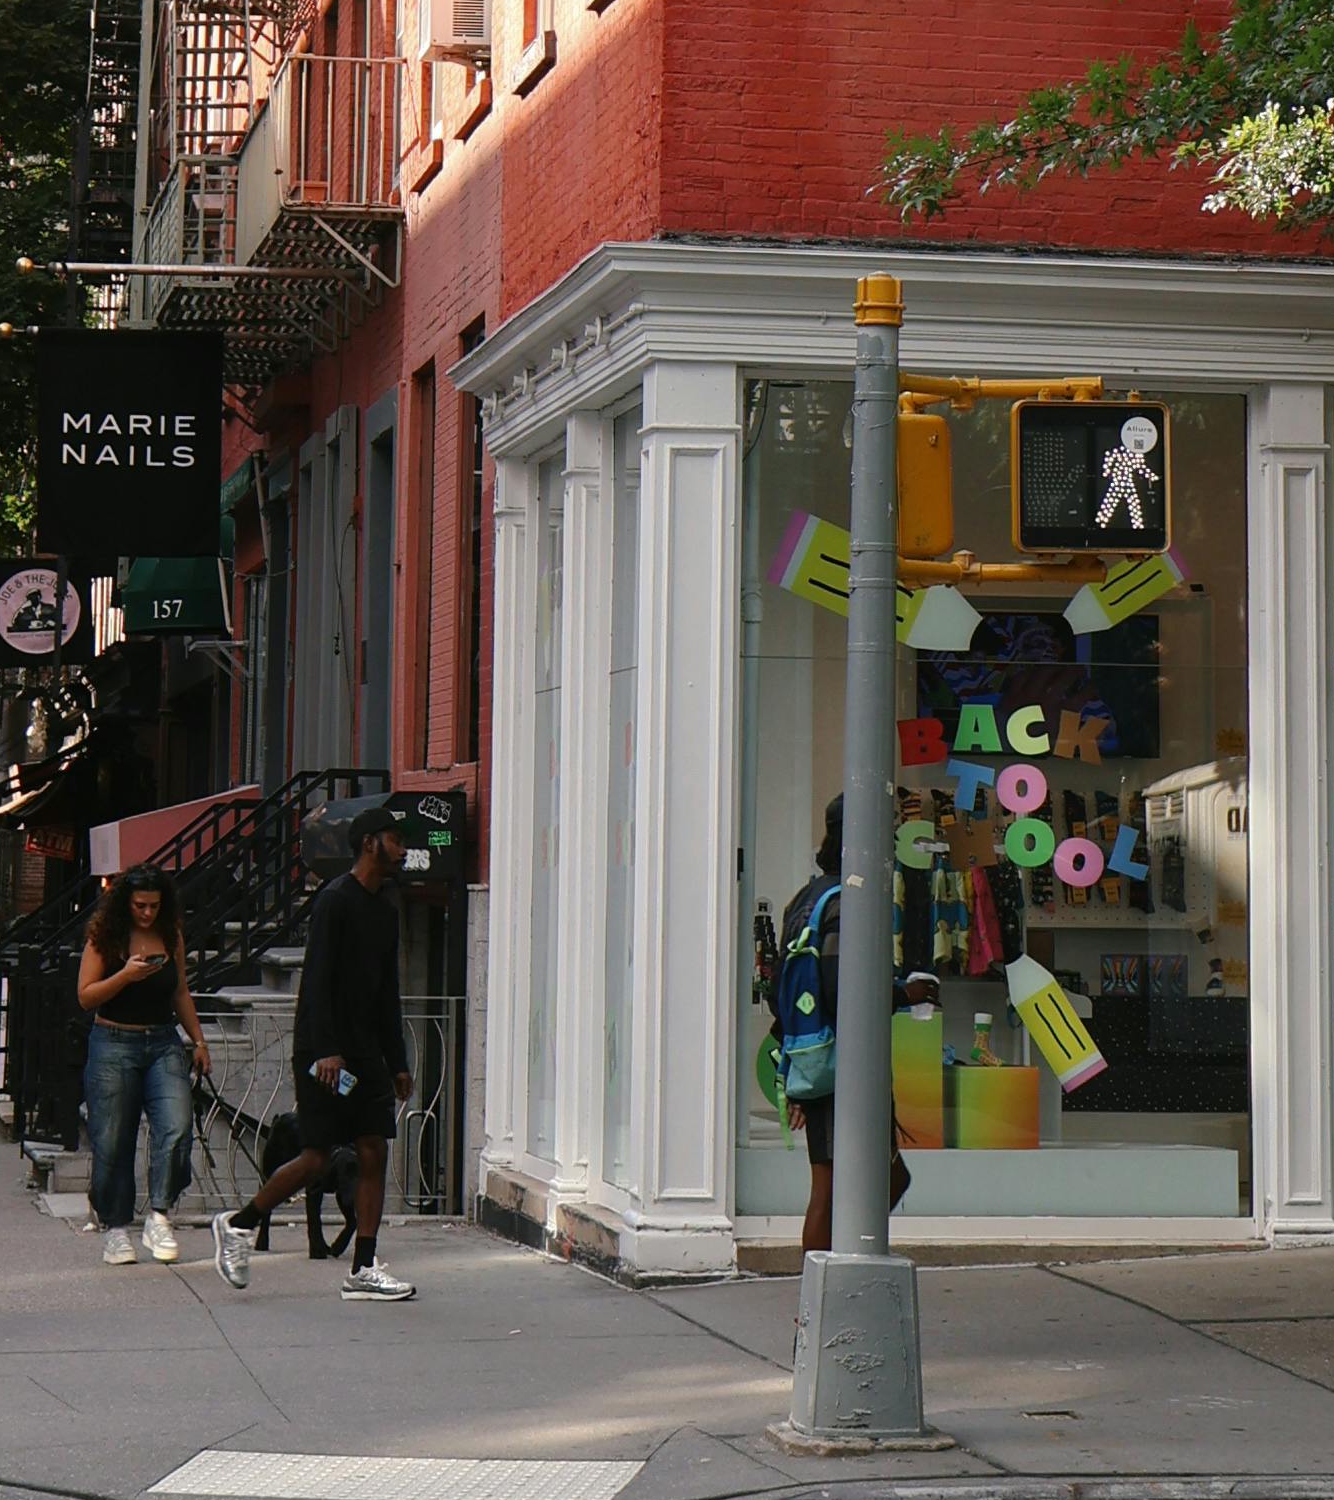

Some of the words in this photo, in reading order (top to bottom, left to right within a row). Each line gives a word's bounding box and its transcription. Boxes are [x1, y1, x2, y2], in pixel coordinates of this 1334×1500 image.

[62, 411, 196, 436] MARIE
[1126, 425, 1153, 433] Allure
[61, 443, 195, 468] NAILS
[24, 574, 46, 585] THE
[152, 599, 183, 619] 157
[897, 703, 1111, 767] BACK
[945, 758, 1048, 814] TO
[894, 817, 1150, 888] CHOOL
